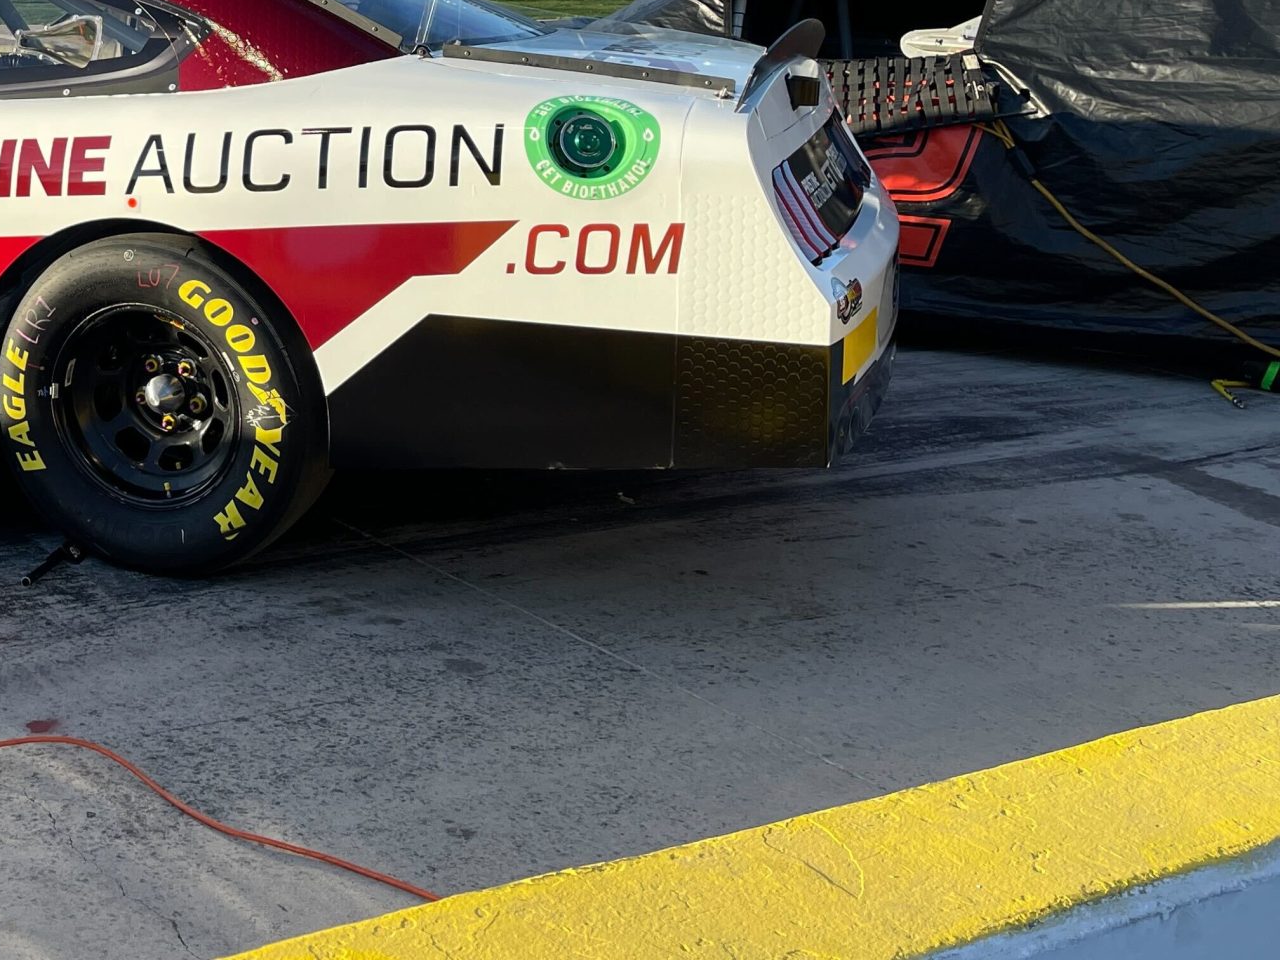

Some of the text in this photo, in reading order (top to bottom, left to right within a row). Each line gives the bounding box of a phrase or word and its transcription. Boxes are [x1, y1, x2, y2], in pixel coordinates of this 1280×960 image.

[125, 123, 505, 195] AUCTION
[536, 157, 652, 200] GET BIOETHANOL
[506, 222, 686, 276] .COM
[2, 338, 47, 472] EAGLE
[178, 279, 287, 541] GOODYEAR
